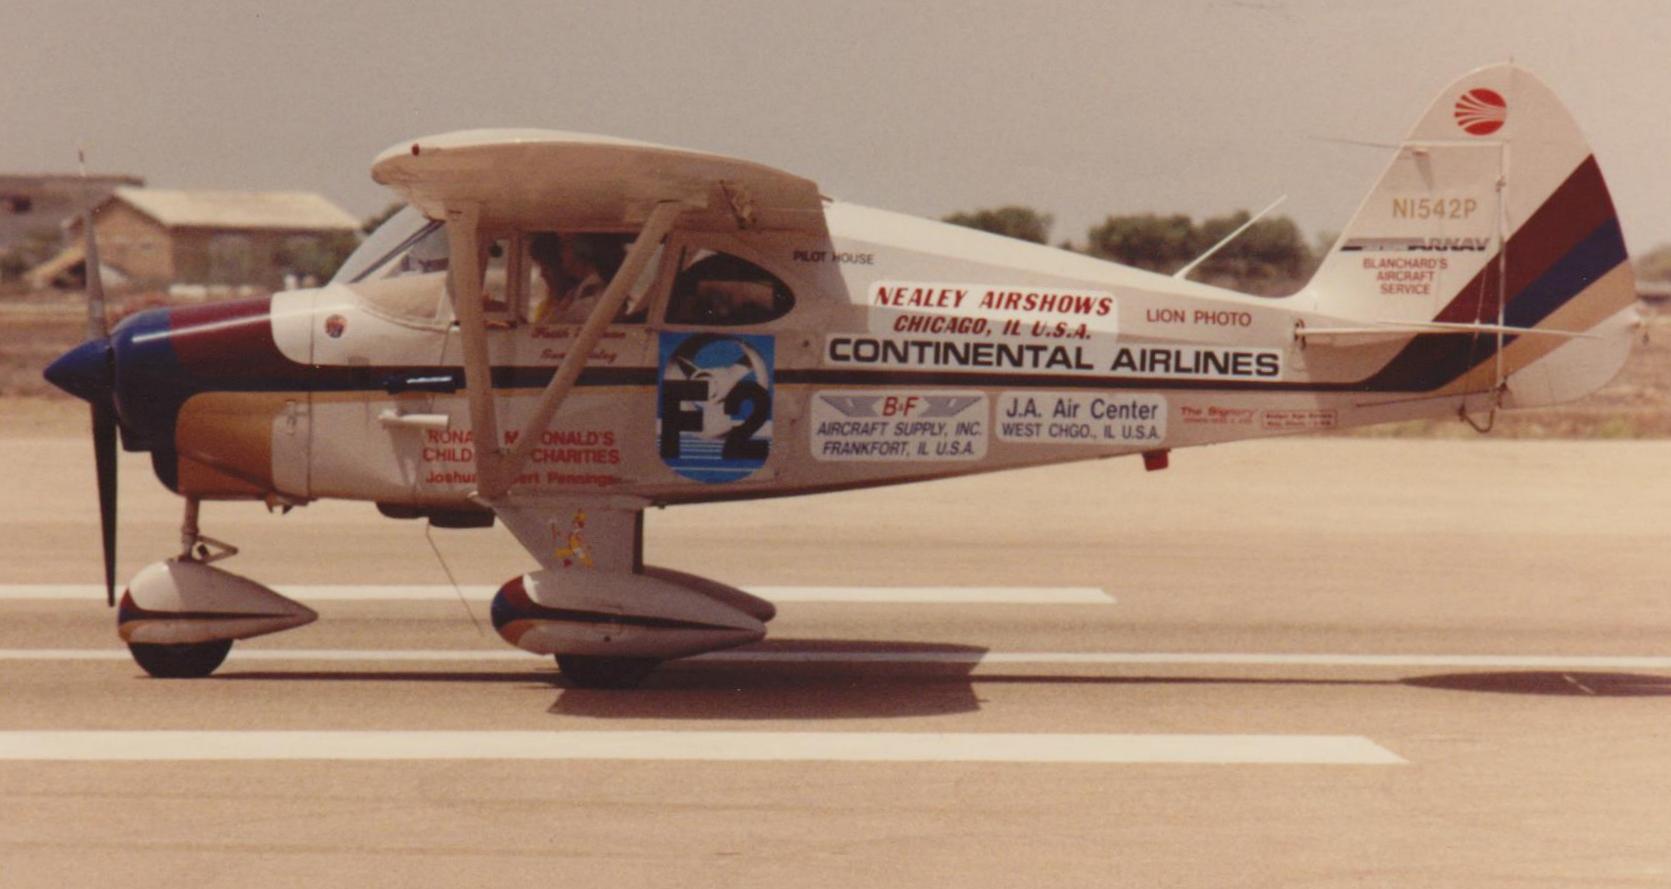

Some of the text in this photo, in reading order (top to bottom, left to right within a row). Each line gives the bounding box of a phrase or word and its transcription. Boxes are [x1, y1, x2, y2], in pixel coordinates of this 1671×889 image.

[793, 250, 875, 265] PILOT HOUSE
[1363, 257, 1448, 269] BLANCHARD'S
[1376, 271, 1435, 281] AIRCRAFT
[1380, 283, 1431, 294] SERVICE
[875, 286, 1113, 316] NEALEY AIRSHOWS
[1146, 308, 1252, 327] LION PHOTO
[893, 315, 1091, 339] CHICAGO, IL U.S.A.
[829, 338, 1280, 376] CONTINENTAL AIRLINES
[1006, 398, 1159, 420] J.A. Air Center
[428, 430, 473, 444] RONA
[817, 422, 982, 437] AIRCRAFT SUPPLY, INC.
[1002, 423, 1042, 437] WEST
[1104, 425, 1115, 439] IL
[823, 441, 911, 456] FRANKFORT,
[917, 442, 929, 455] IL
[531, 450, 620, 464] CHARITIES
